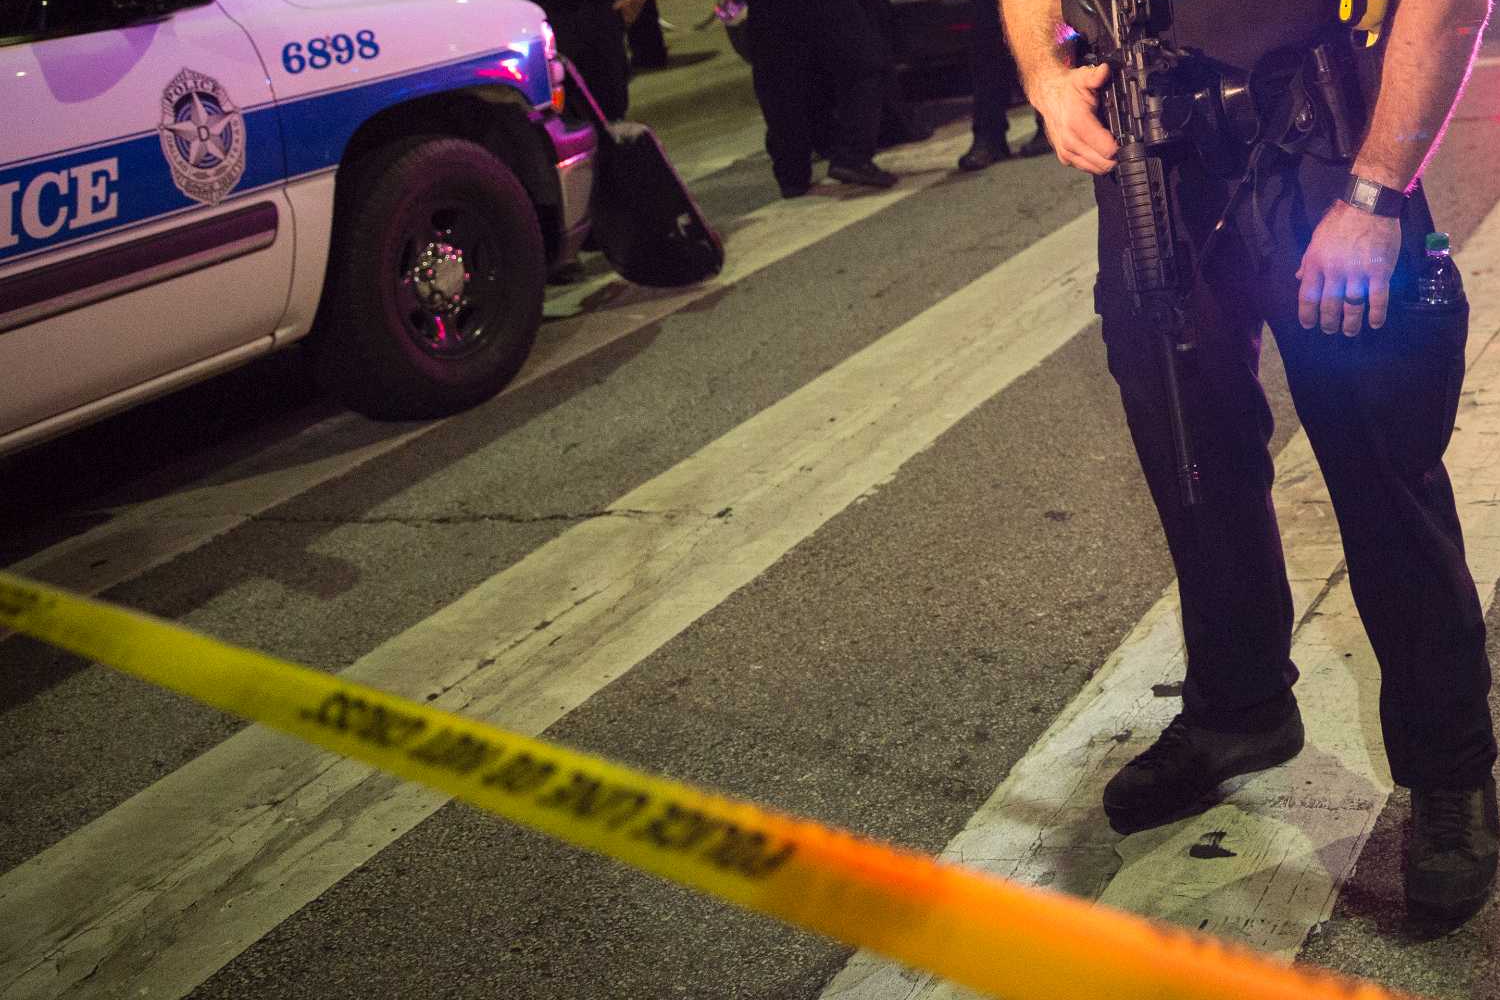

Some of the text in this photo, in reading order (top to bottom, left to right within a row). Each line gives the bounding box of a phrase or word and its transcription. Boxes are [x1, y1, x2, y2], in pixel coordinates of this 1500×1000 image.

[282, 29, 380, 75] 6898
[165, 81, 220, 104] POLICE
[197, 125, 210, 141] D
